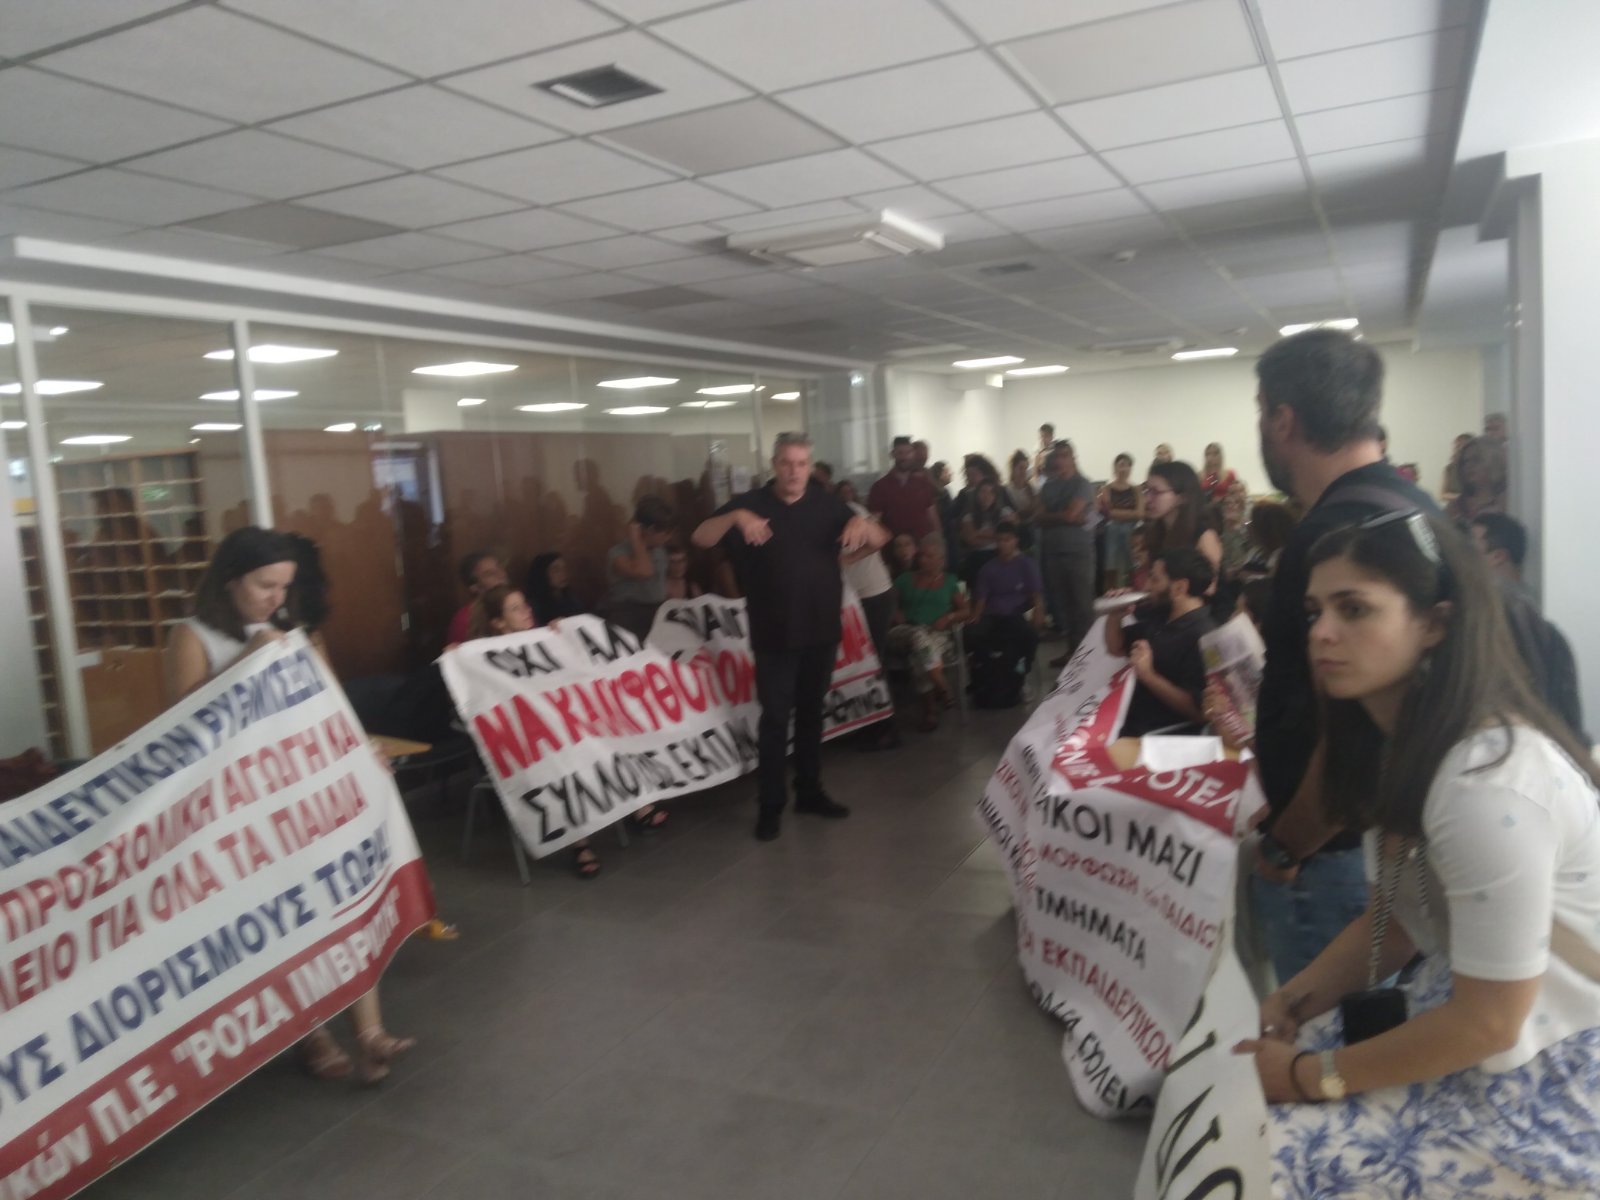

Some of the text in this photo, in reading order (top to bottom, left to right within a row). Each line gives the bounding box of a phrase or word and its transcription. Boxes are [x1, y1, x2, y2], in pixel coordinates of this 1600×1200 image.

[222, 727, 329, 814] ΑΓΩΓΗ
[474, 694, 563, 778] ΝΑ
[149, 848, 224, 921] ΟΛΑ
[215, 823, 275, 881] ΤΑ
[1127, 820, 1204, 888] ΜΑΖΙ
[1034, 886, 1146, 970] ΤΜΗΜΑΤΑ
[68, 883, 317, 1063] ΔΙΟΡΙΣΜΟΥΣ
